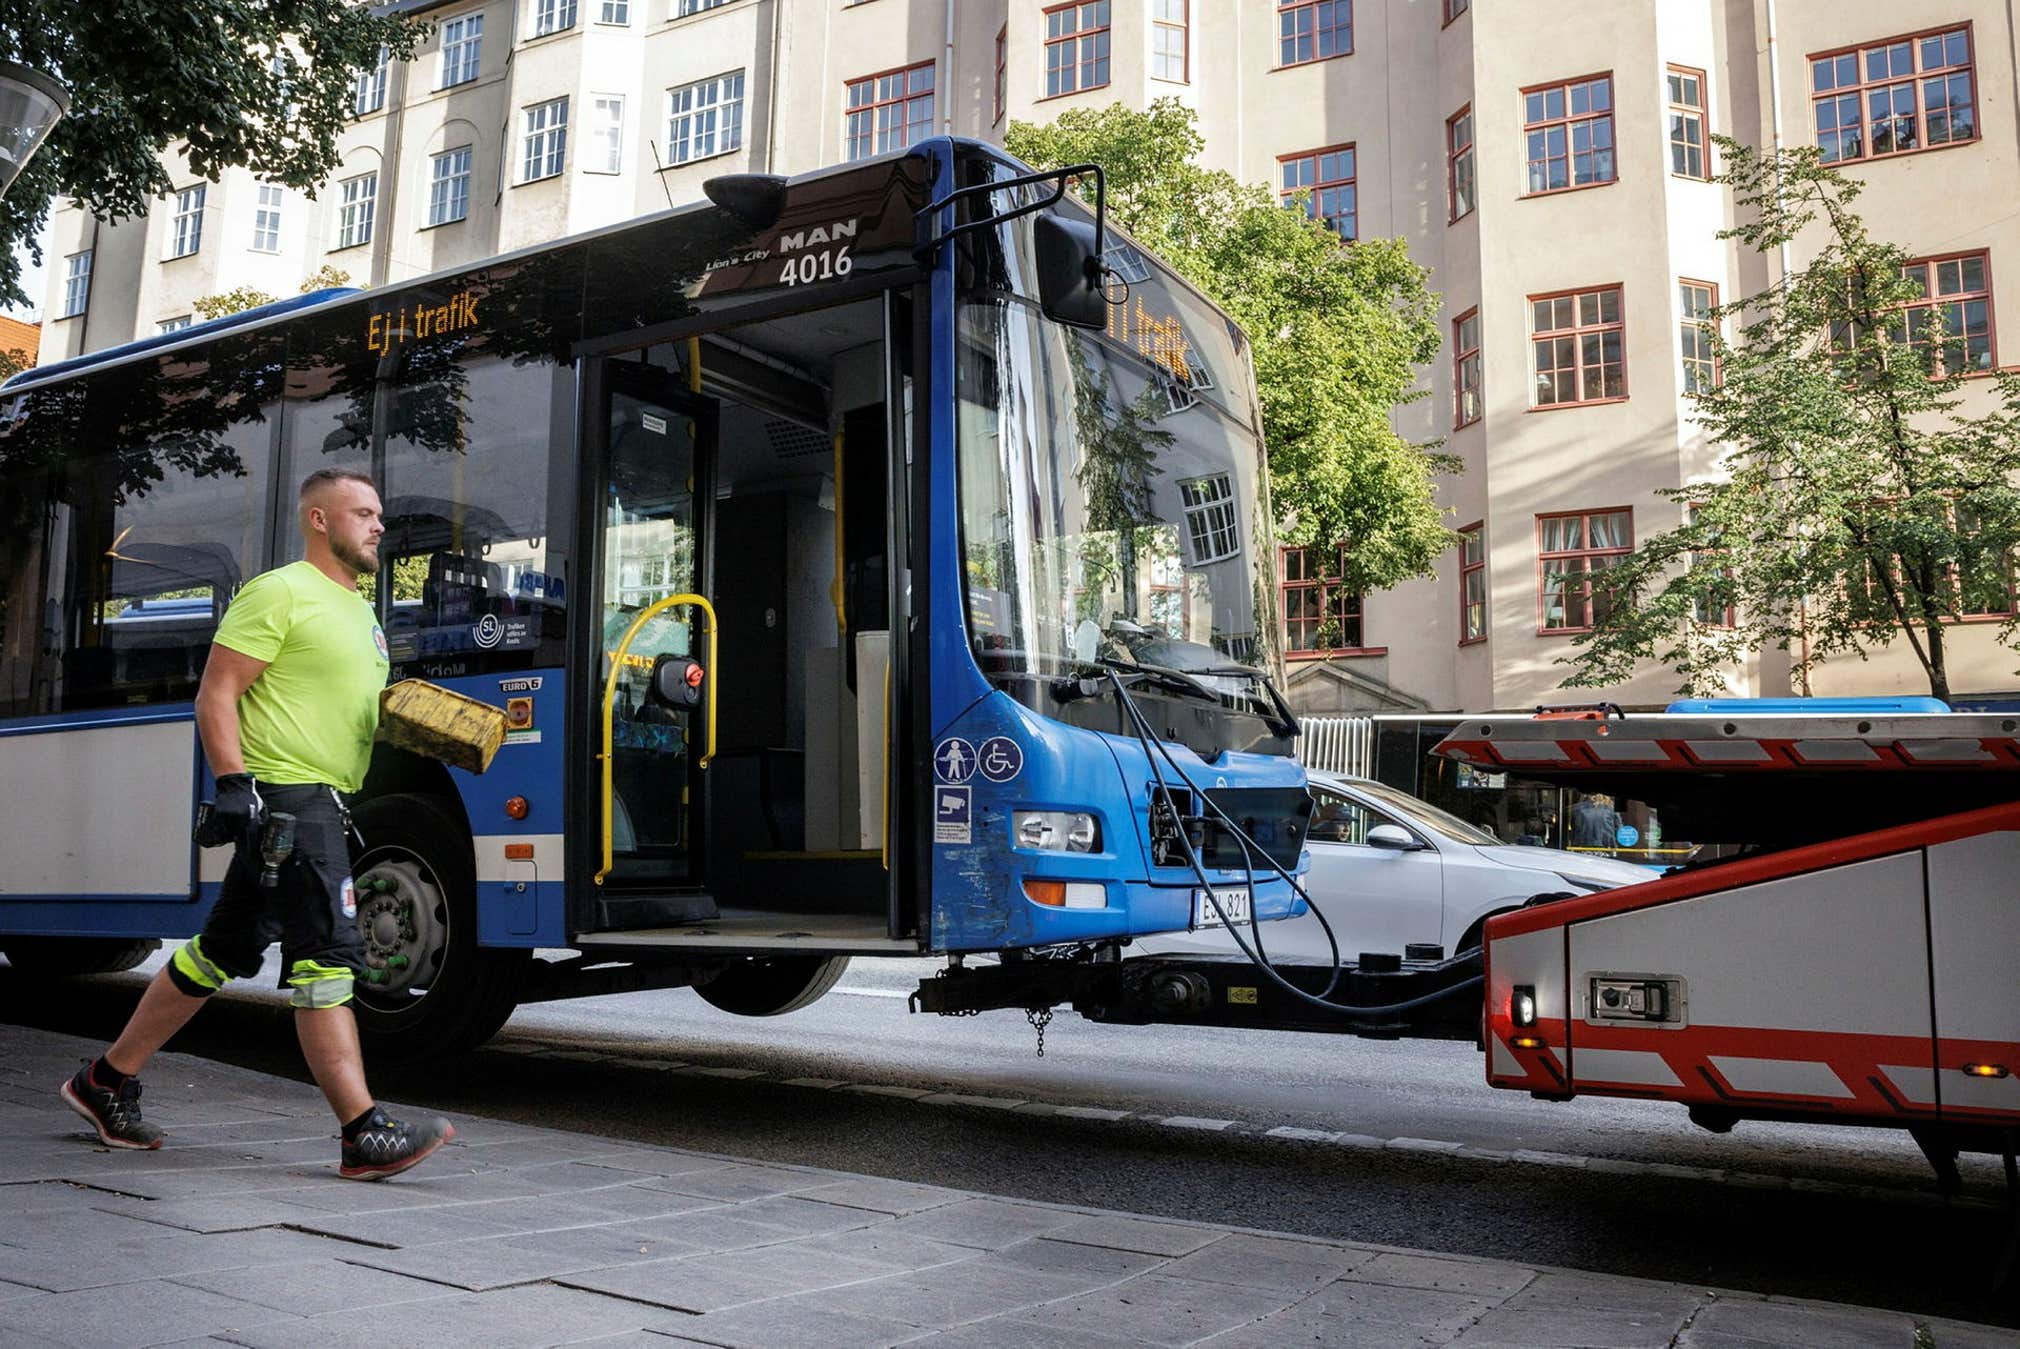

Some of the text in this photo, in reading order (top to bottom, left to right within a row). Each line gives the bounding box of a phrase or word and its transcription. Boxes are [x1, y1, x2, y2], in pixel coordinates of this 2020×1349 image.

[780, 219, 857, 253] MAN
[704, 250, 771, 272] Lion's City
[779, 246, 853, 287] 4016
[368, 291, 479, 357] Ej i trafik
[483, 621, 495, 633] SL
[502, 679, 540, 692] EURO 6
[1227, 893, 1246, 917] 821
